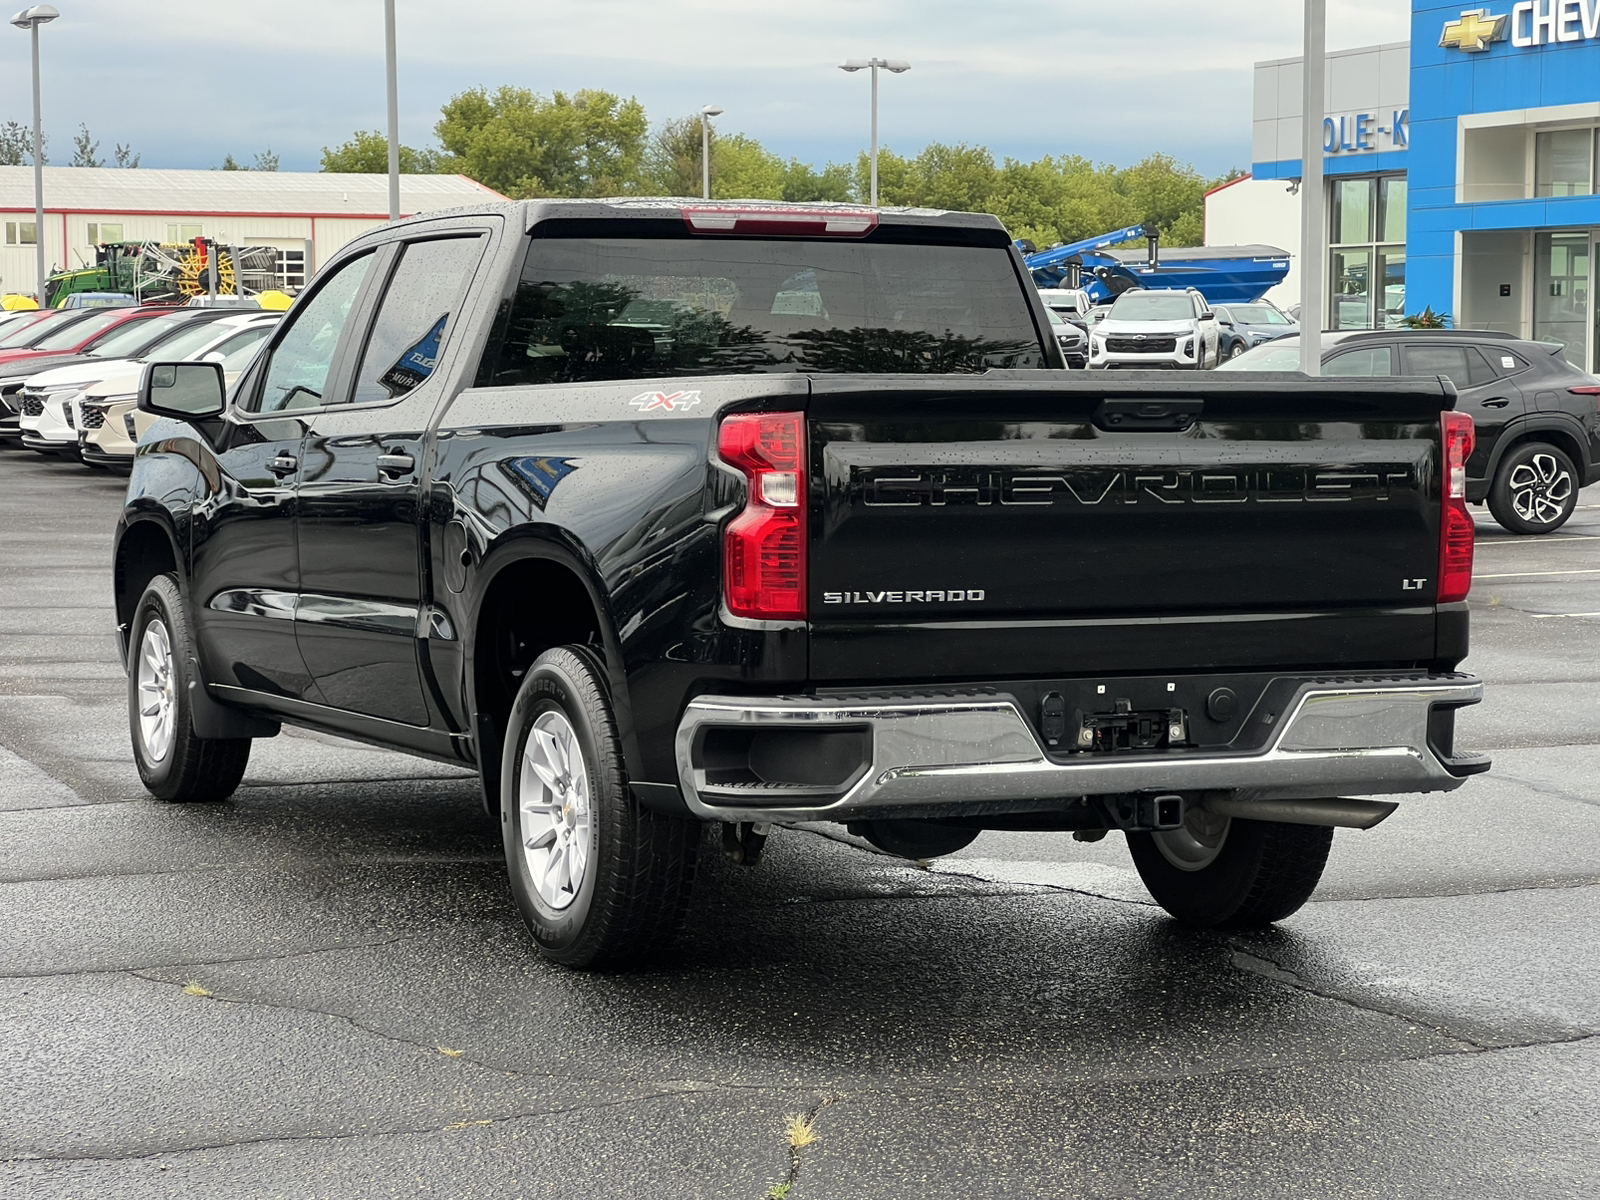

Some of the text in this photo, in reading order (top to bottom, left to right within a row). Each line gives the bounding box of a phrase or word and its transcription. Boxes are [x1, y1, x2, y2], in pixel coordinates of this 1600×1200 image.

[1512, 0, 1600, 47] CHEV
[864, 472, 1408, 505] CHEVROLET
[1402, 578, 1427, 590] LT
[823, 589, 985, 604] SILVERADO
